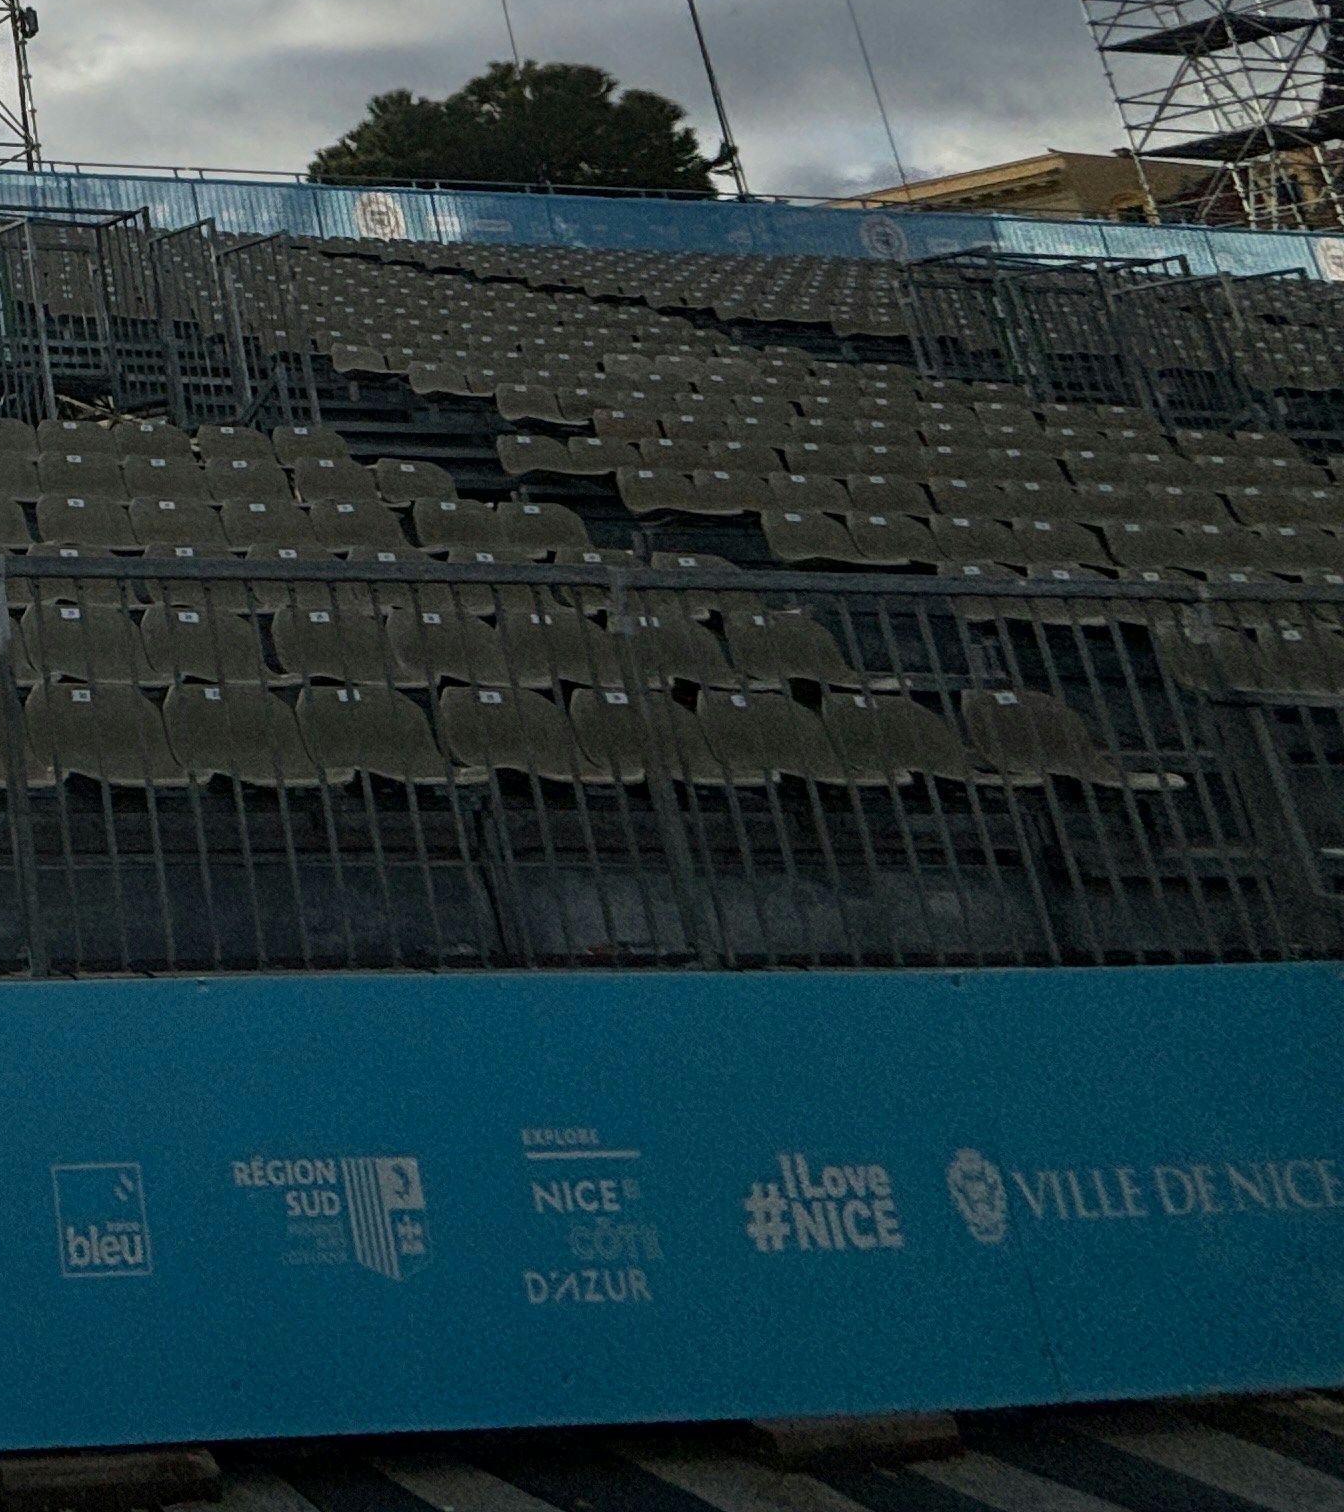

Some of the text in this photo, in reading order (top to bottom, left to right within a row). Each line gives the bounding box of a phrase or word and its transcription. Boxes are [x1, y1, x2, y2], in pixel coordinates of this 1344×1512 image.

[522, 1128, 600, 1145] EXPLORE
[230, 1155, 338, 1187] RÉGION
[285, 1190, 341, 1218] SUD
[531, 1178, 621, 1213] NICE
[1010, 1158, 1344, 1220] VILLE DE NICE
[66, 1224, 143, 1266] bleu
